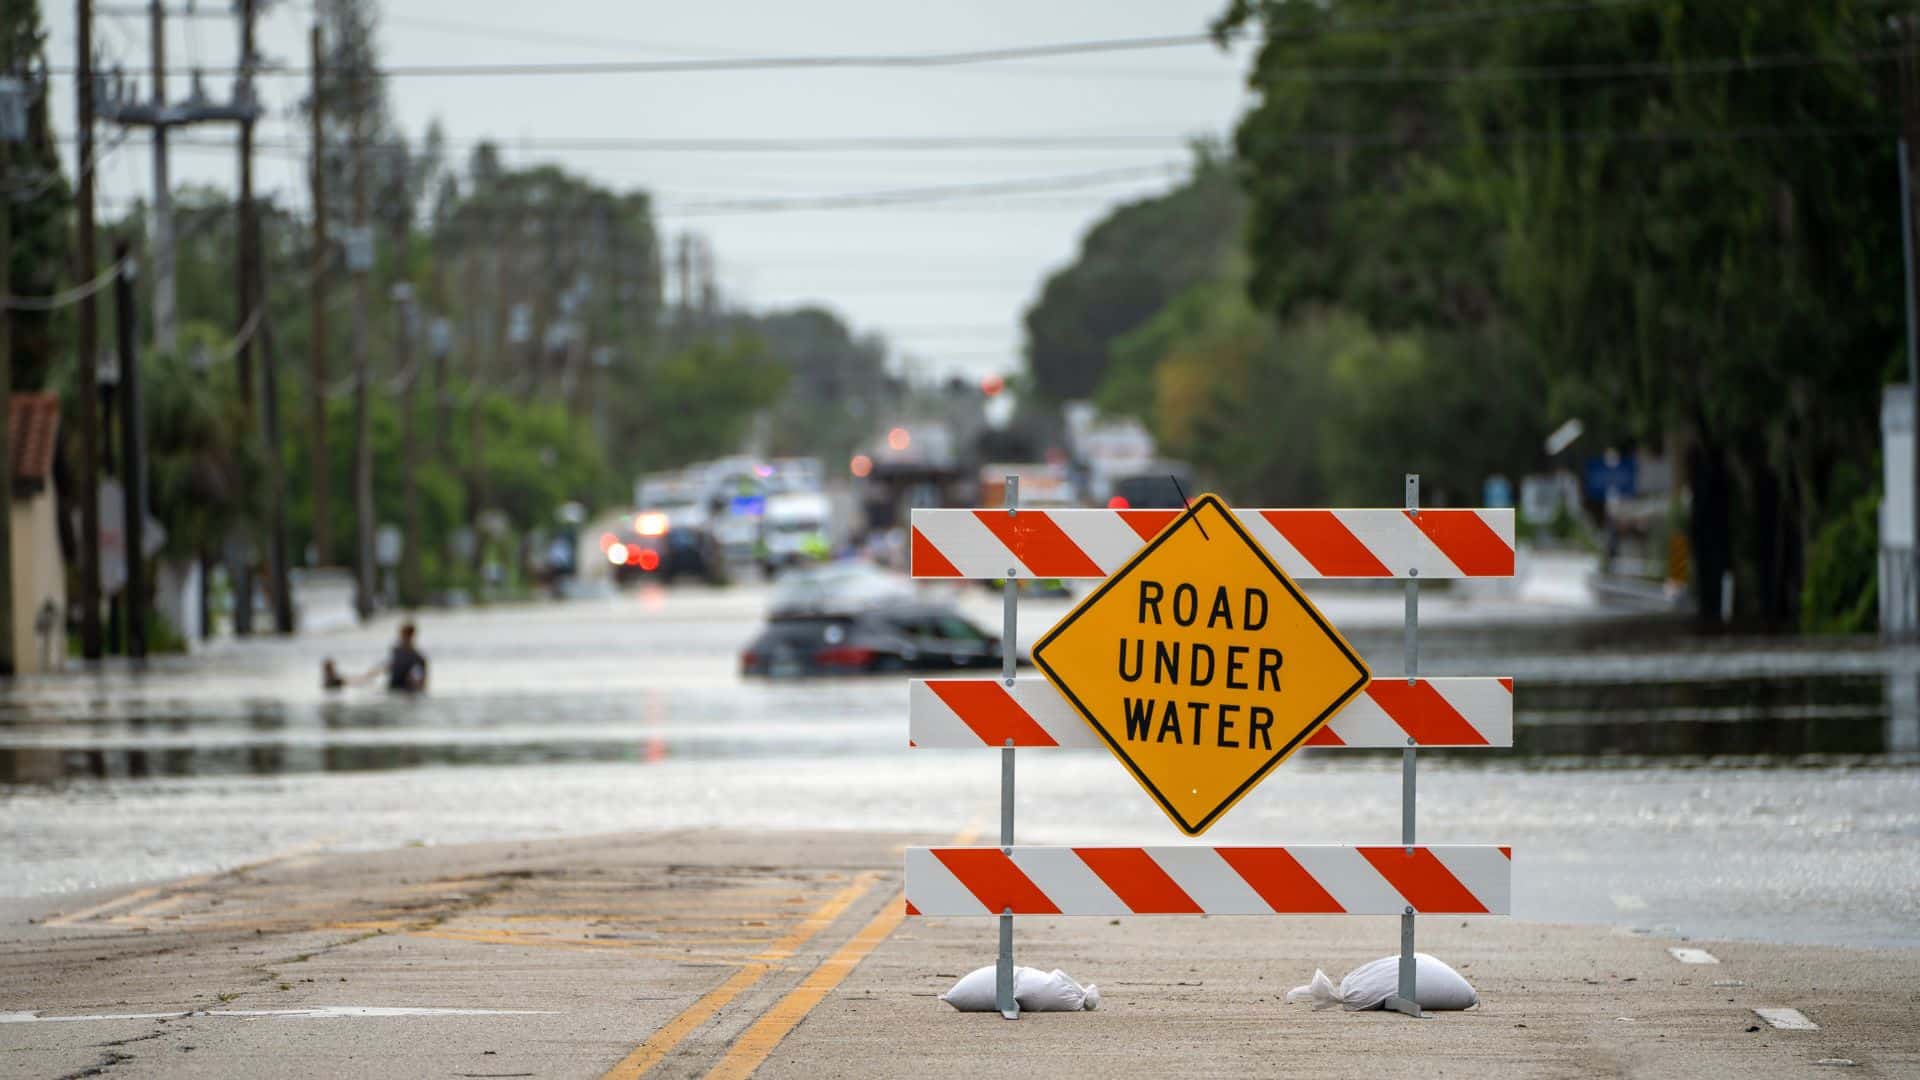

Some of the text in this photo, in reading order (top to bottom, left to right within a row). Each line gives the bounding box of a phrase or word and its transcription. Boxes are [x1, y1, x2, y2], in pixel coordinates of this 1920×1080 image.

[1138, 580, 1269, 632] ROAD
[1118, 638, 1284, 693] UNDER
[1123, 697, 1274, 751] WATER
